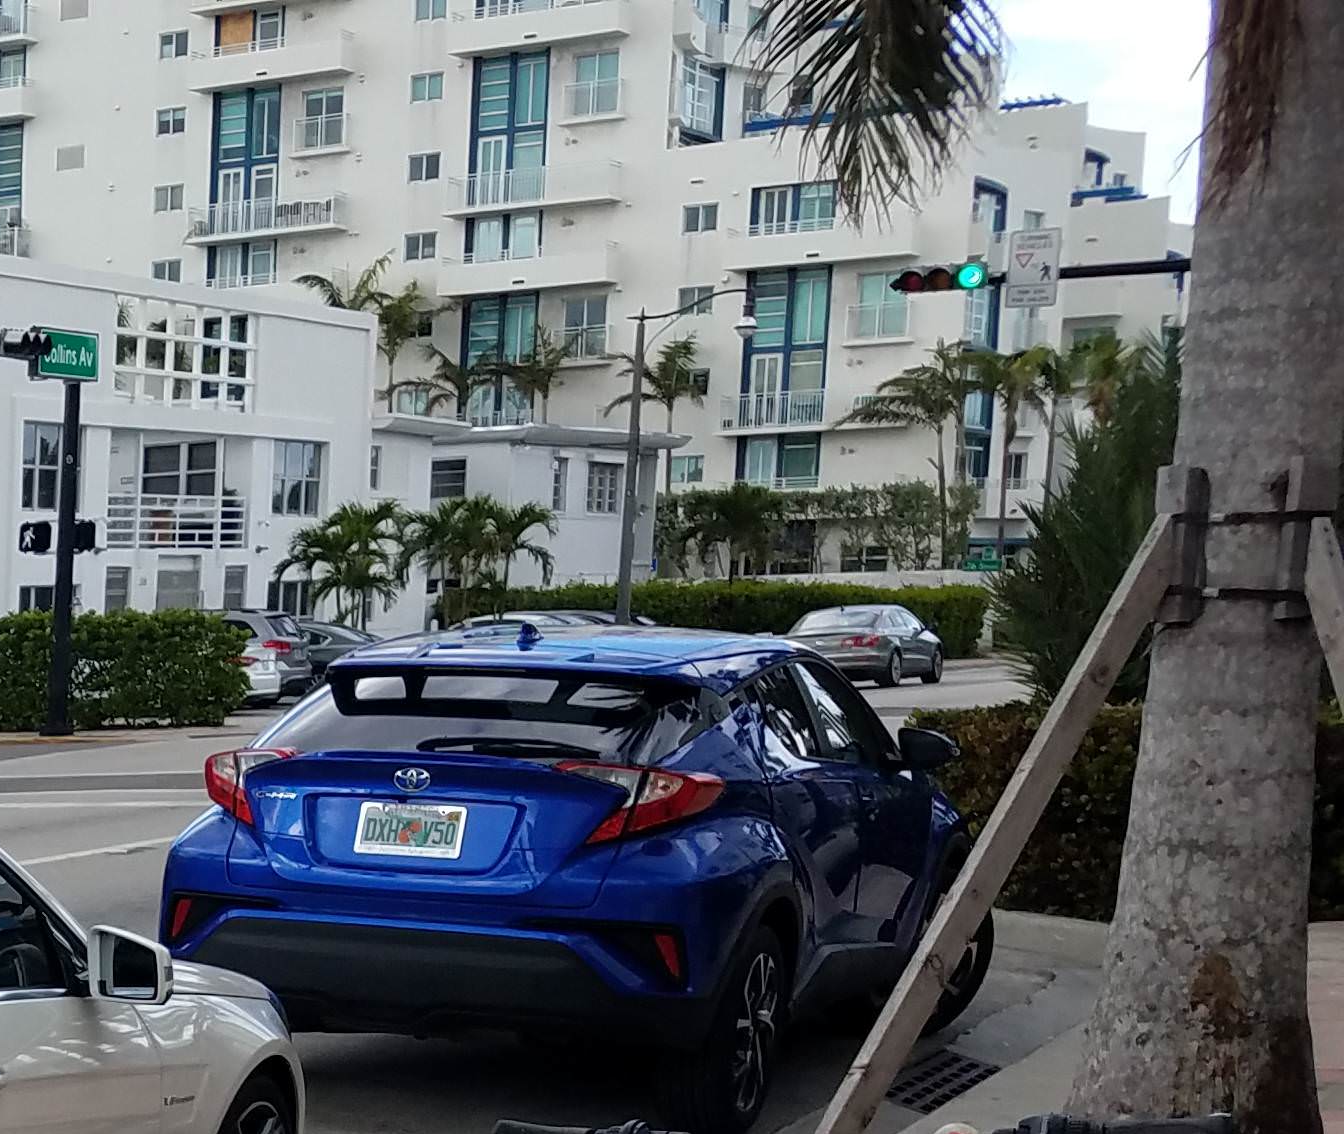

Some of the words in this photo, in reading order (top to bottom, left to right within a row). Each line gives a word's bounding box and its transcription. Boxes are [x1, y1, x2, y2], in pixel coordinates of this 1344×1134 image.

[79, 346, 93, 368] Av
[364, 817, 401, 842] DXH
[423, 820, 457, 845] V50
